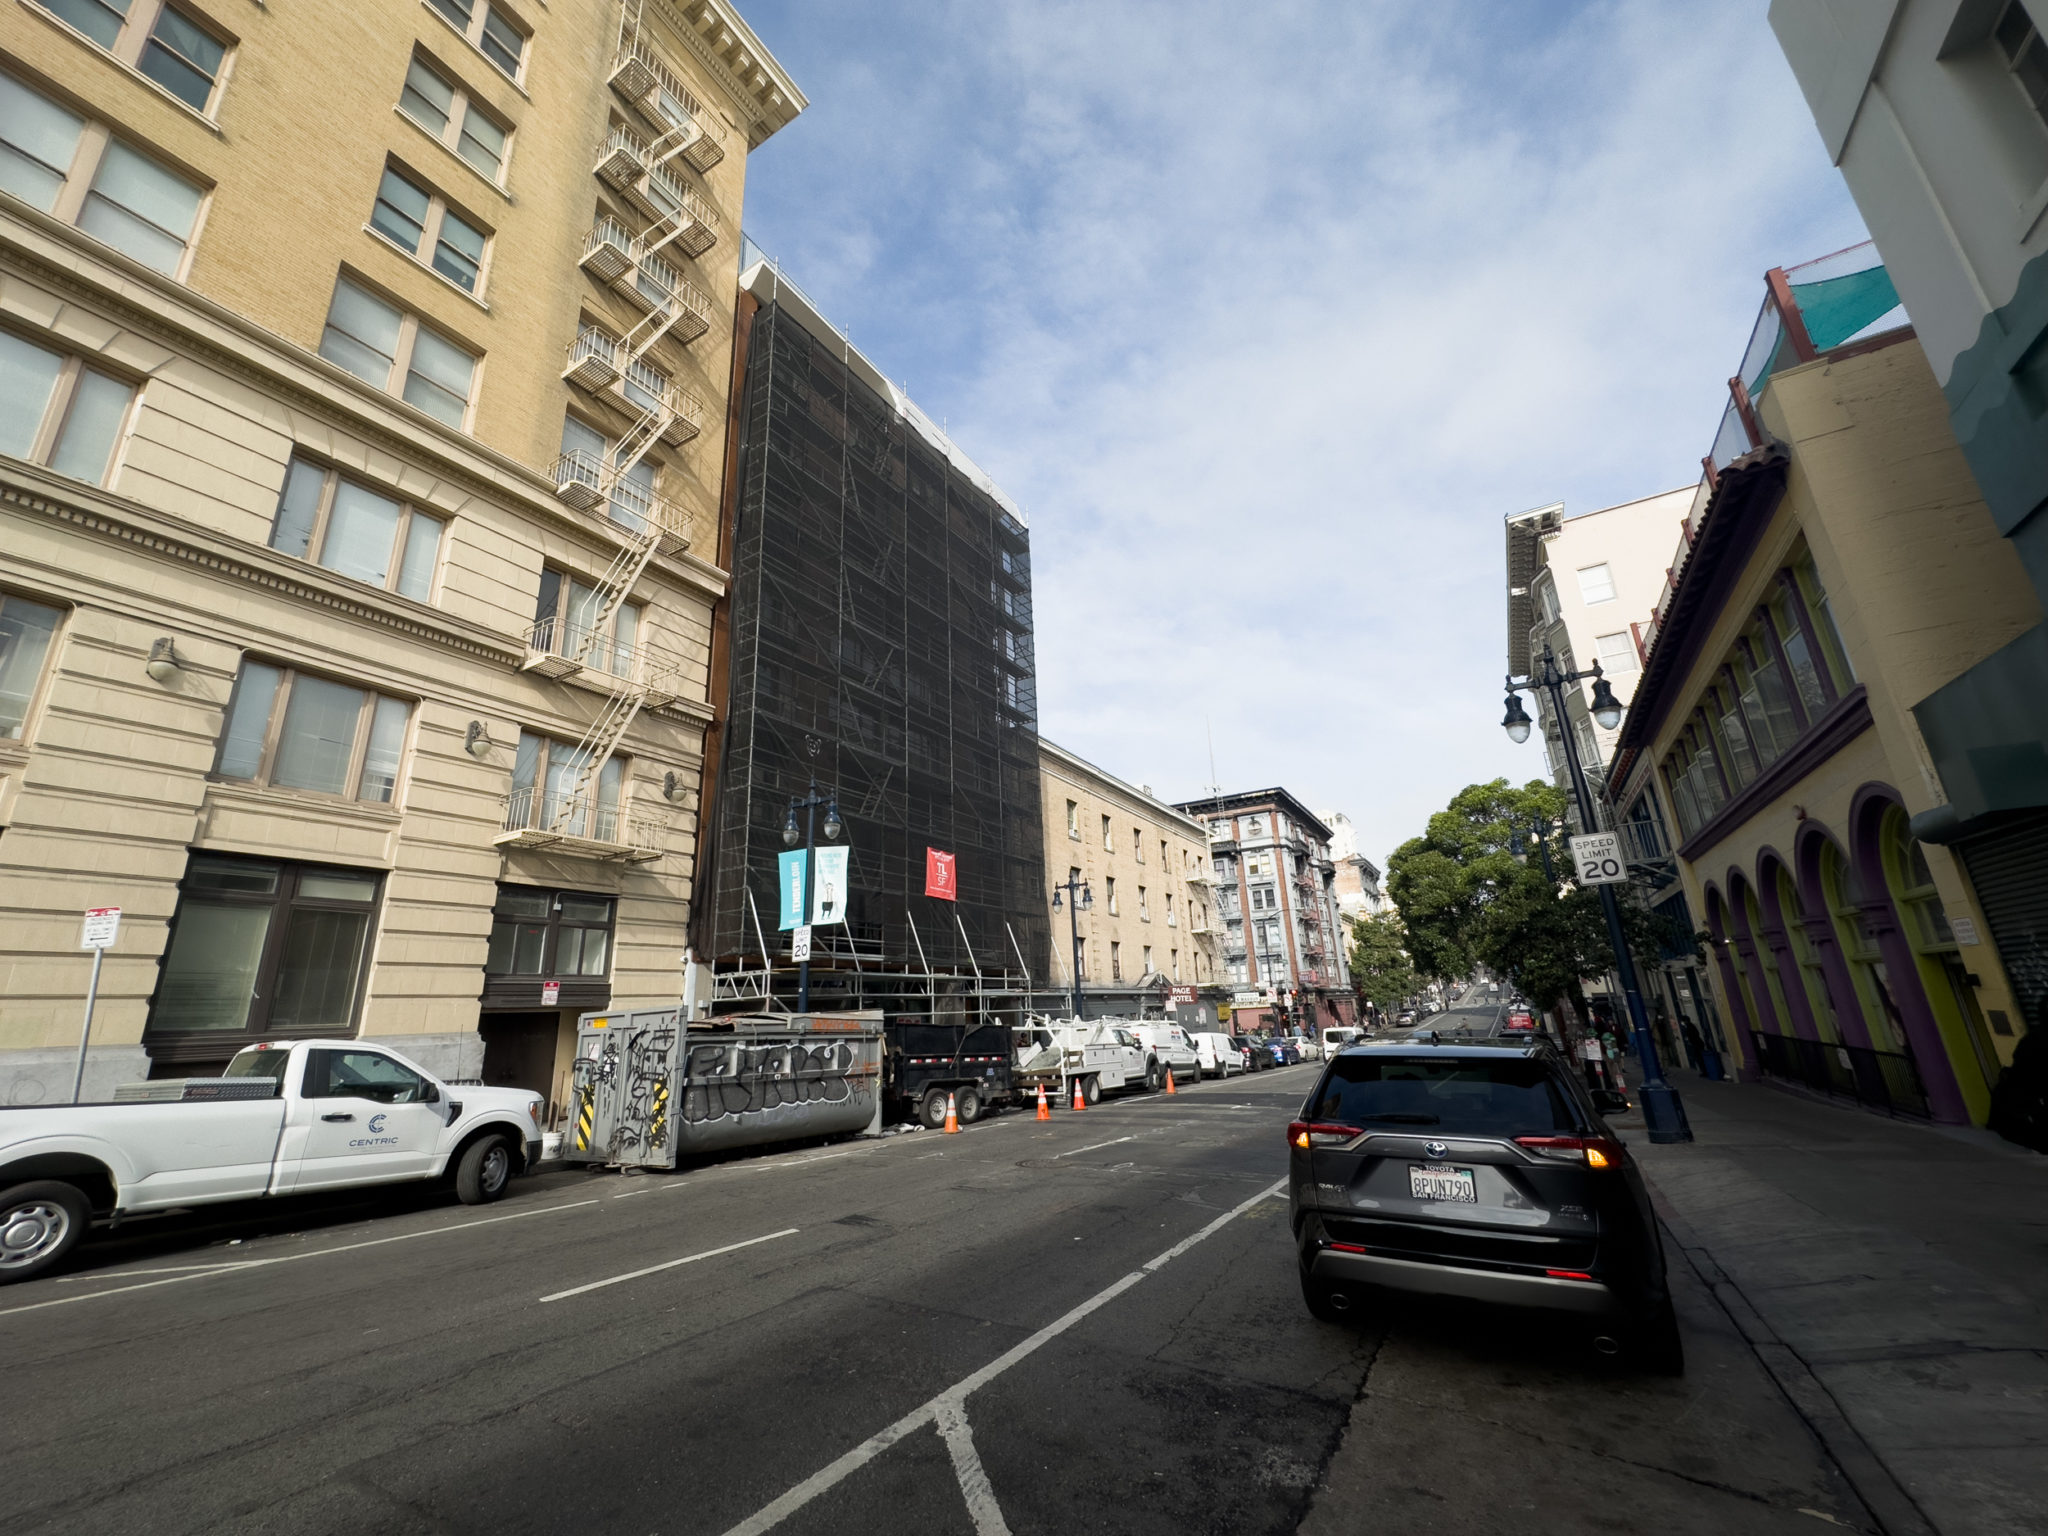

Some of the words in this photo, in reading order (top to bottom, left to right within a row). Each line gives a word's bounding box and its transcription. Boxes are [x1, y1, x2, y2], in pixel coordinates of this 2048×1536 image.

[1575, 838, 1614, 849] SPEED
[1582, 848, 1611, 859] LIMIT
[936, 862, 947, 875] TL
[1582, 859, 1619, 879] 20
[791, 861, 801, 914] TENDERLOIN
[794, 944, 808, 957] 20
[1172, 987, 1191, 995] PAGE
[1170, 995, 1194, 1003] HOTEL
[349, 1137, 399, 1147] CENTRIC
[1425, 1165, 1455, 1173] TOYOTA
[1413, 1177, 1471, 1197] 8PUN790
[1430, 1193, 1475, 1203] FRANCISCO
